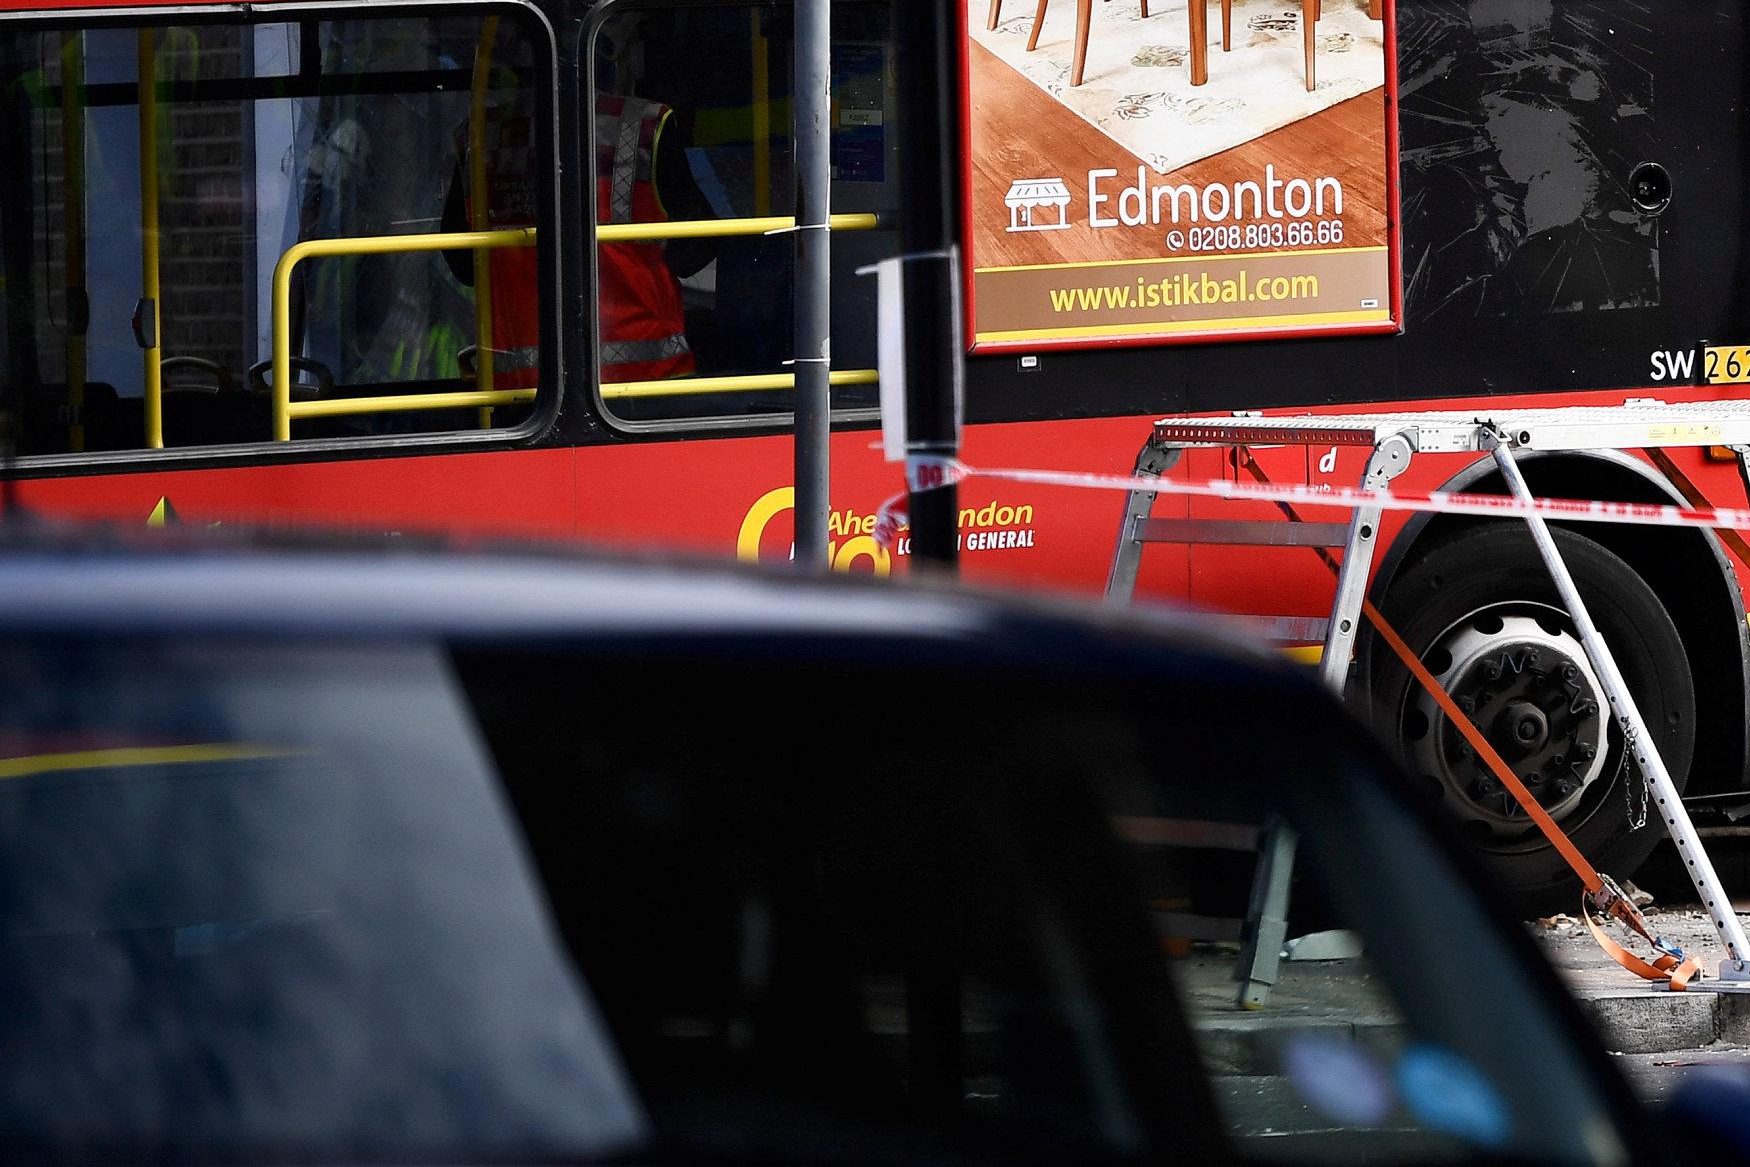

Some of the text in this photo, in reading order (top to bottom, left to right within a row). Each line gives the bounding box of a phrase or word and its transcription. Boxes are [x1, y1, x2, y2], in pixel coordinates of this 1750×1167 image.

[1087, 163, 1344, 229] Edmonton
[1188, 220, 1344, 252] 0208.803.66.66
[1049, 270, 1319, 313] www.istikbal.com
[1650, 349, 1695, 380] SW
[966, 529, 1035, 552] GENERAL
